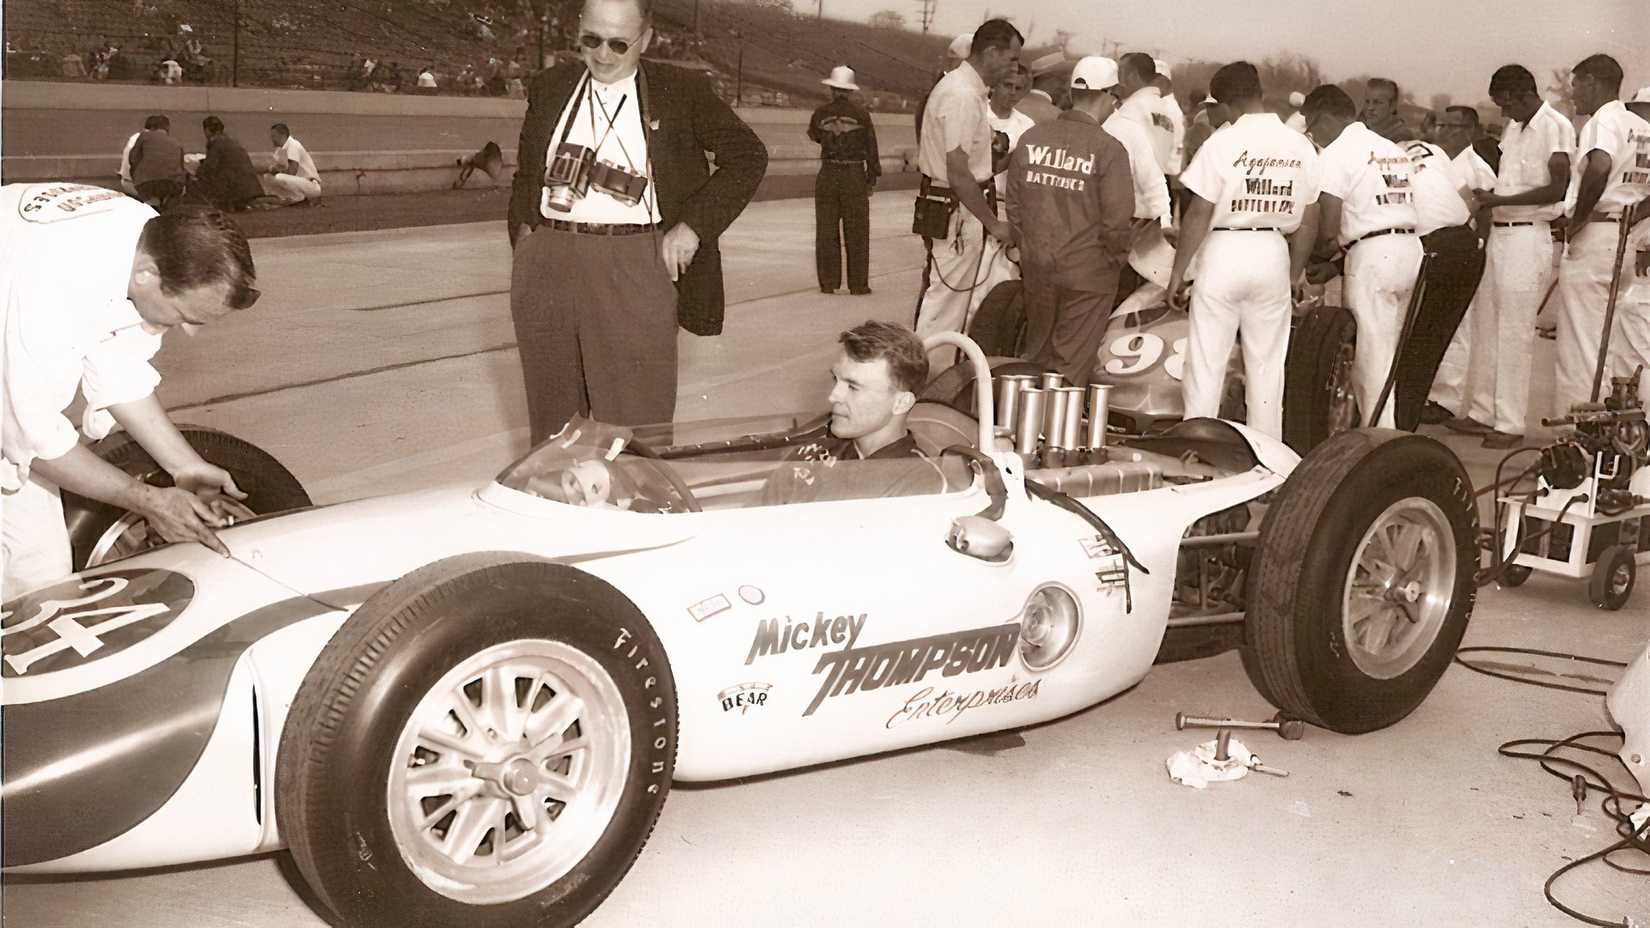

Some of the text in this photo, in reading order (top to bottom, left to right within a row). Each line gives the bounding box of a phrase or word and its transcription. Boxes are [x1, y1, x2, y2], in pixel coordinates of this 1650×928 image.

[1025, 144, 1095, 175] Willard
[1245, 178, 1293, 196] Willard
[744, 611, 868, 665] Mickey
[802, 622, 1021, 718] THOMPSON
[613, 627, 667, 794] Firestone
[722, 692, 768, 712] BEAR
[886, 675, 1042, 729] Enterprises
